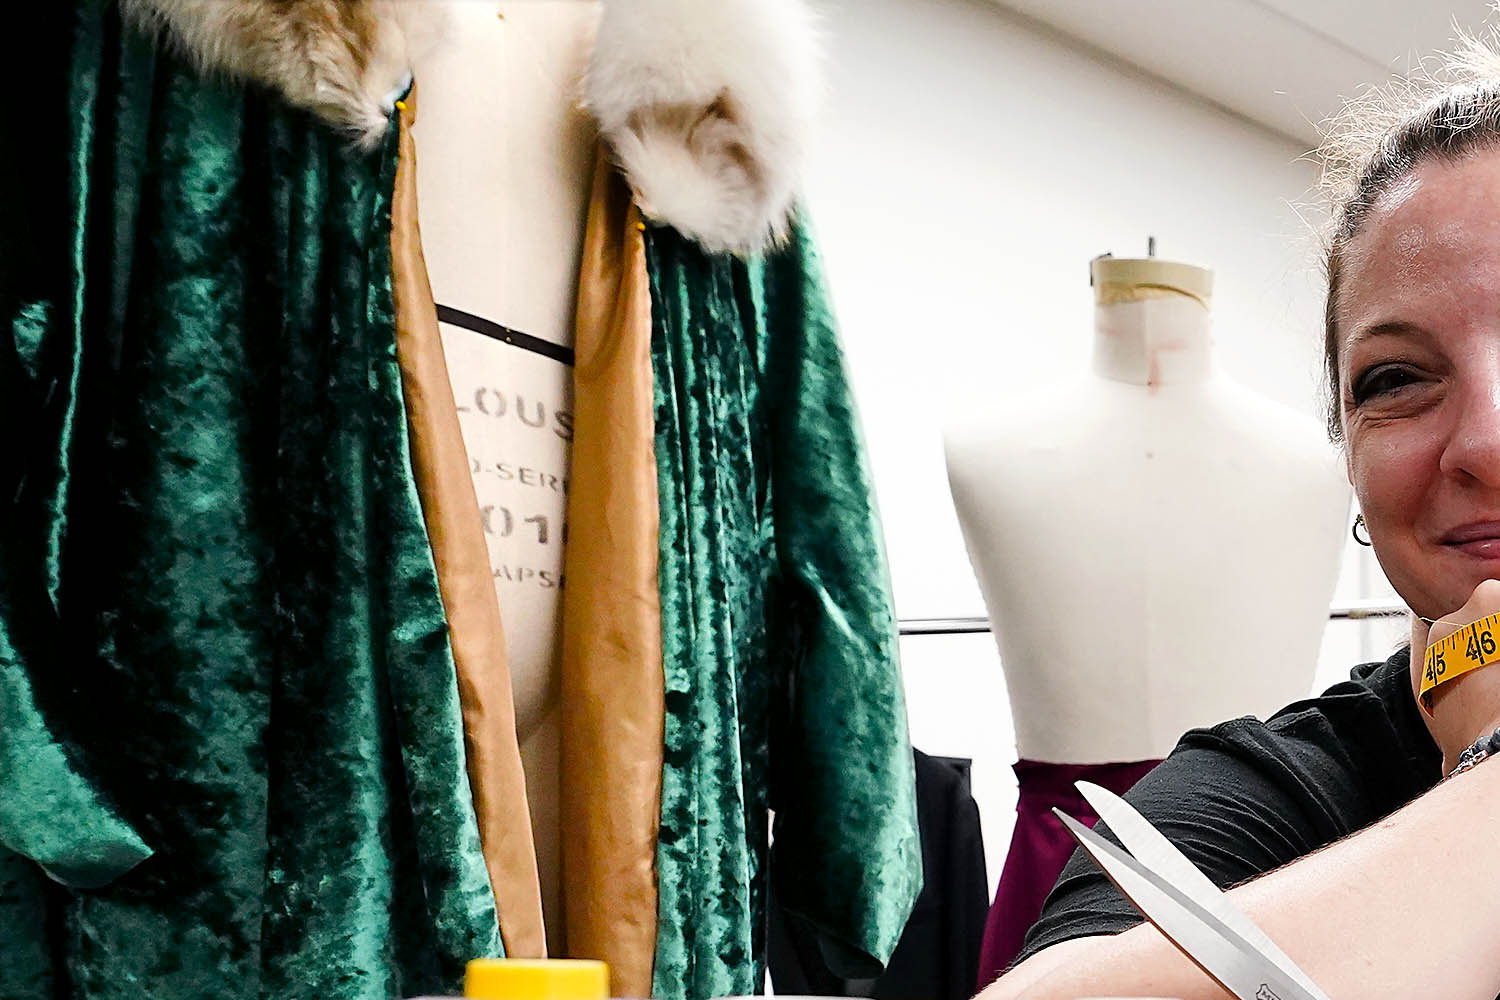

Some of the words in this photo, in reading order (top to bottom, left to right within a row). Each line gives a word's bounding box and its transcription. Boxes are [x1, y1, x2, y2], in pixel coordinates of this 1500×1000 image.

[456, 386, 574, 441] OUS
[1425, 651, 1446, 683] 45
[1465, 630, 1497, 662] 46
